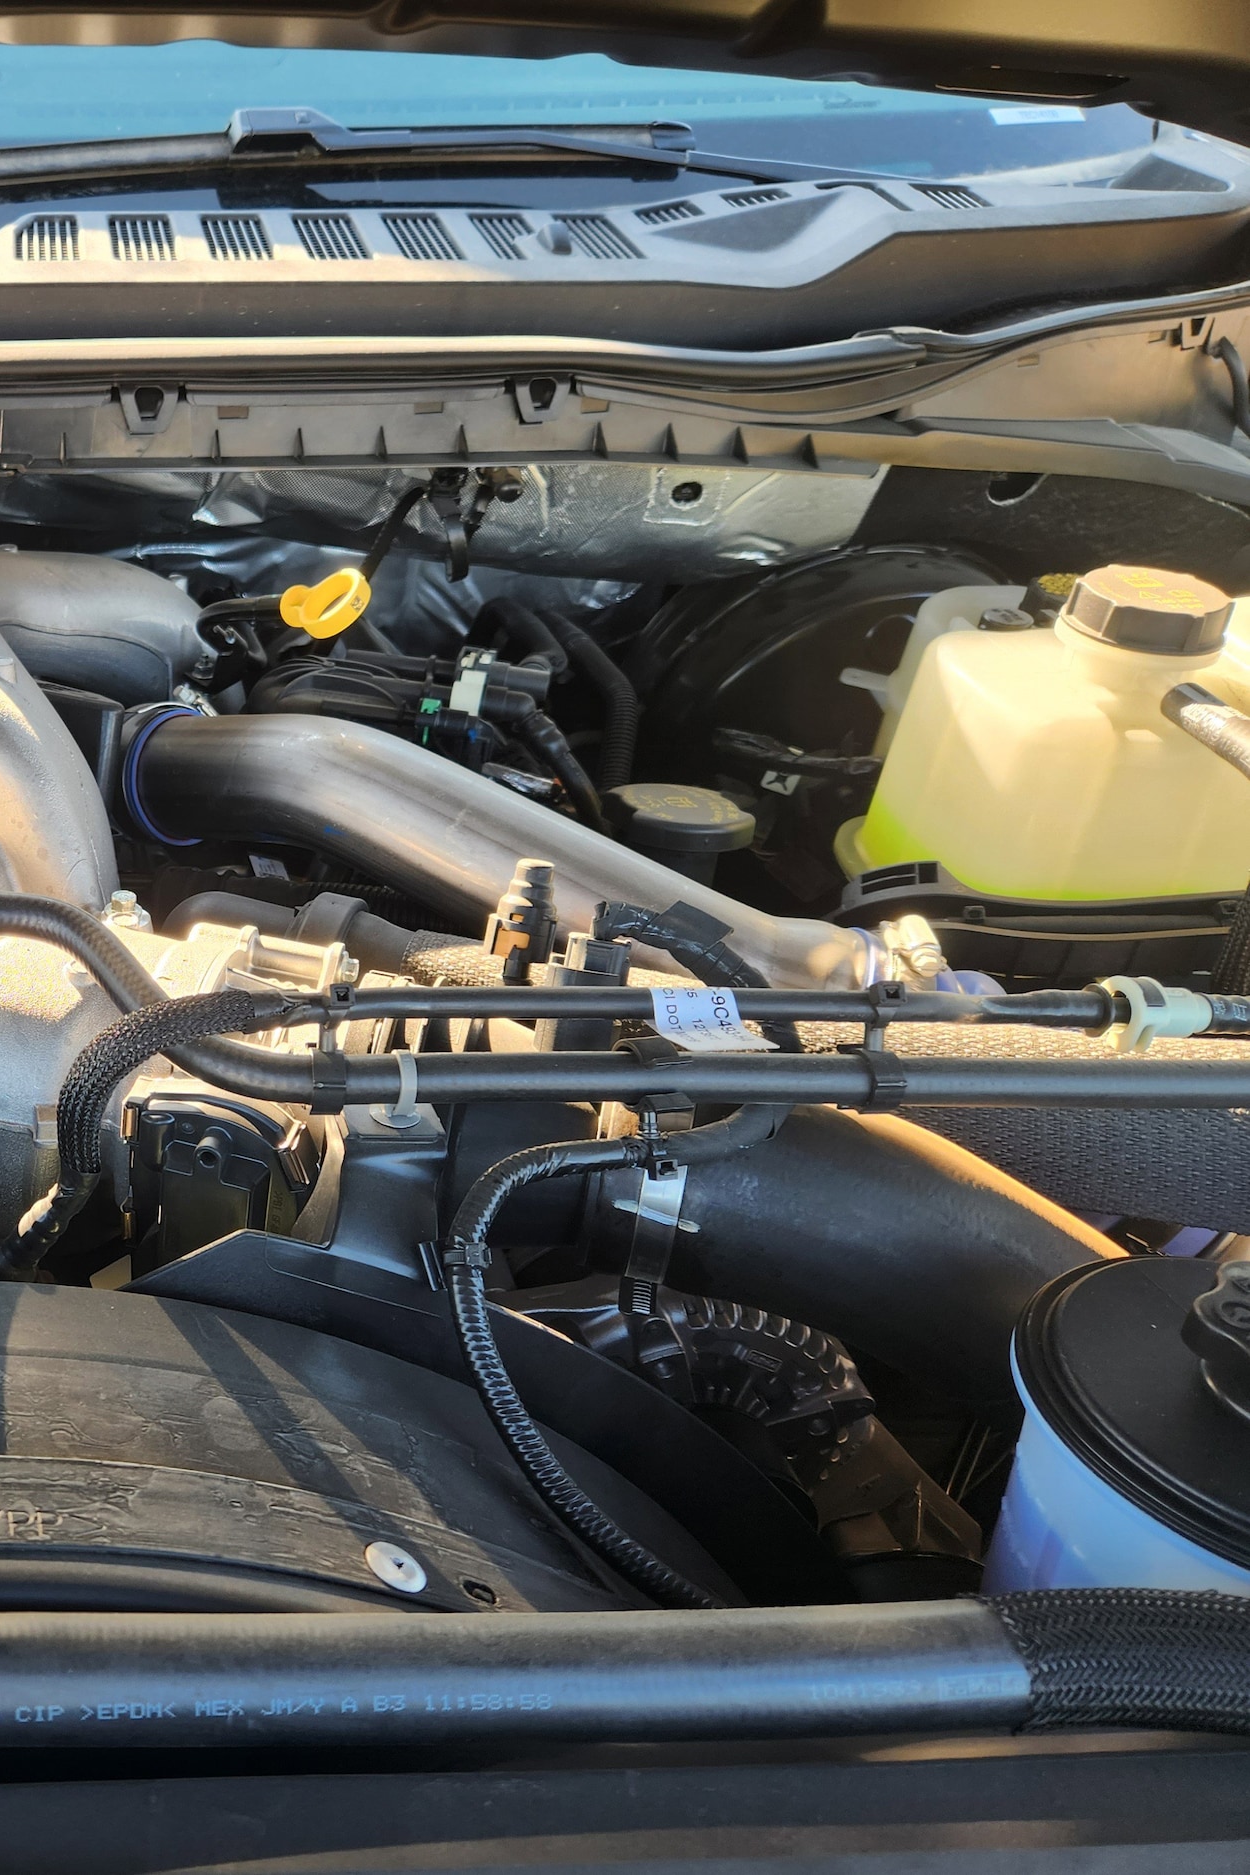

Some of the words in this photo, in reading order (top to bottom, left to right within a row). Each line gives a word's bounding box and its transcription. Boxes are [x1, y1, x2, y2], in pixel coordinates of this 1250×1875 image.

[14, 1704, 66, 1722] CIP
[80, 1700, 176, 1721] >EPDM<
[194, 1698, 244, 1717] MEX
[340, 1695, 358, 1714] A
